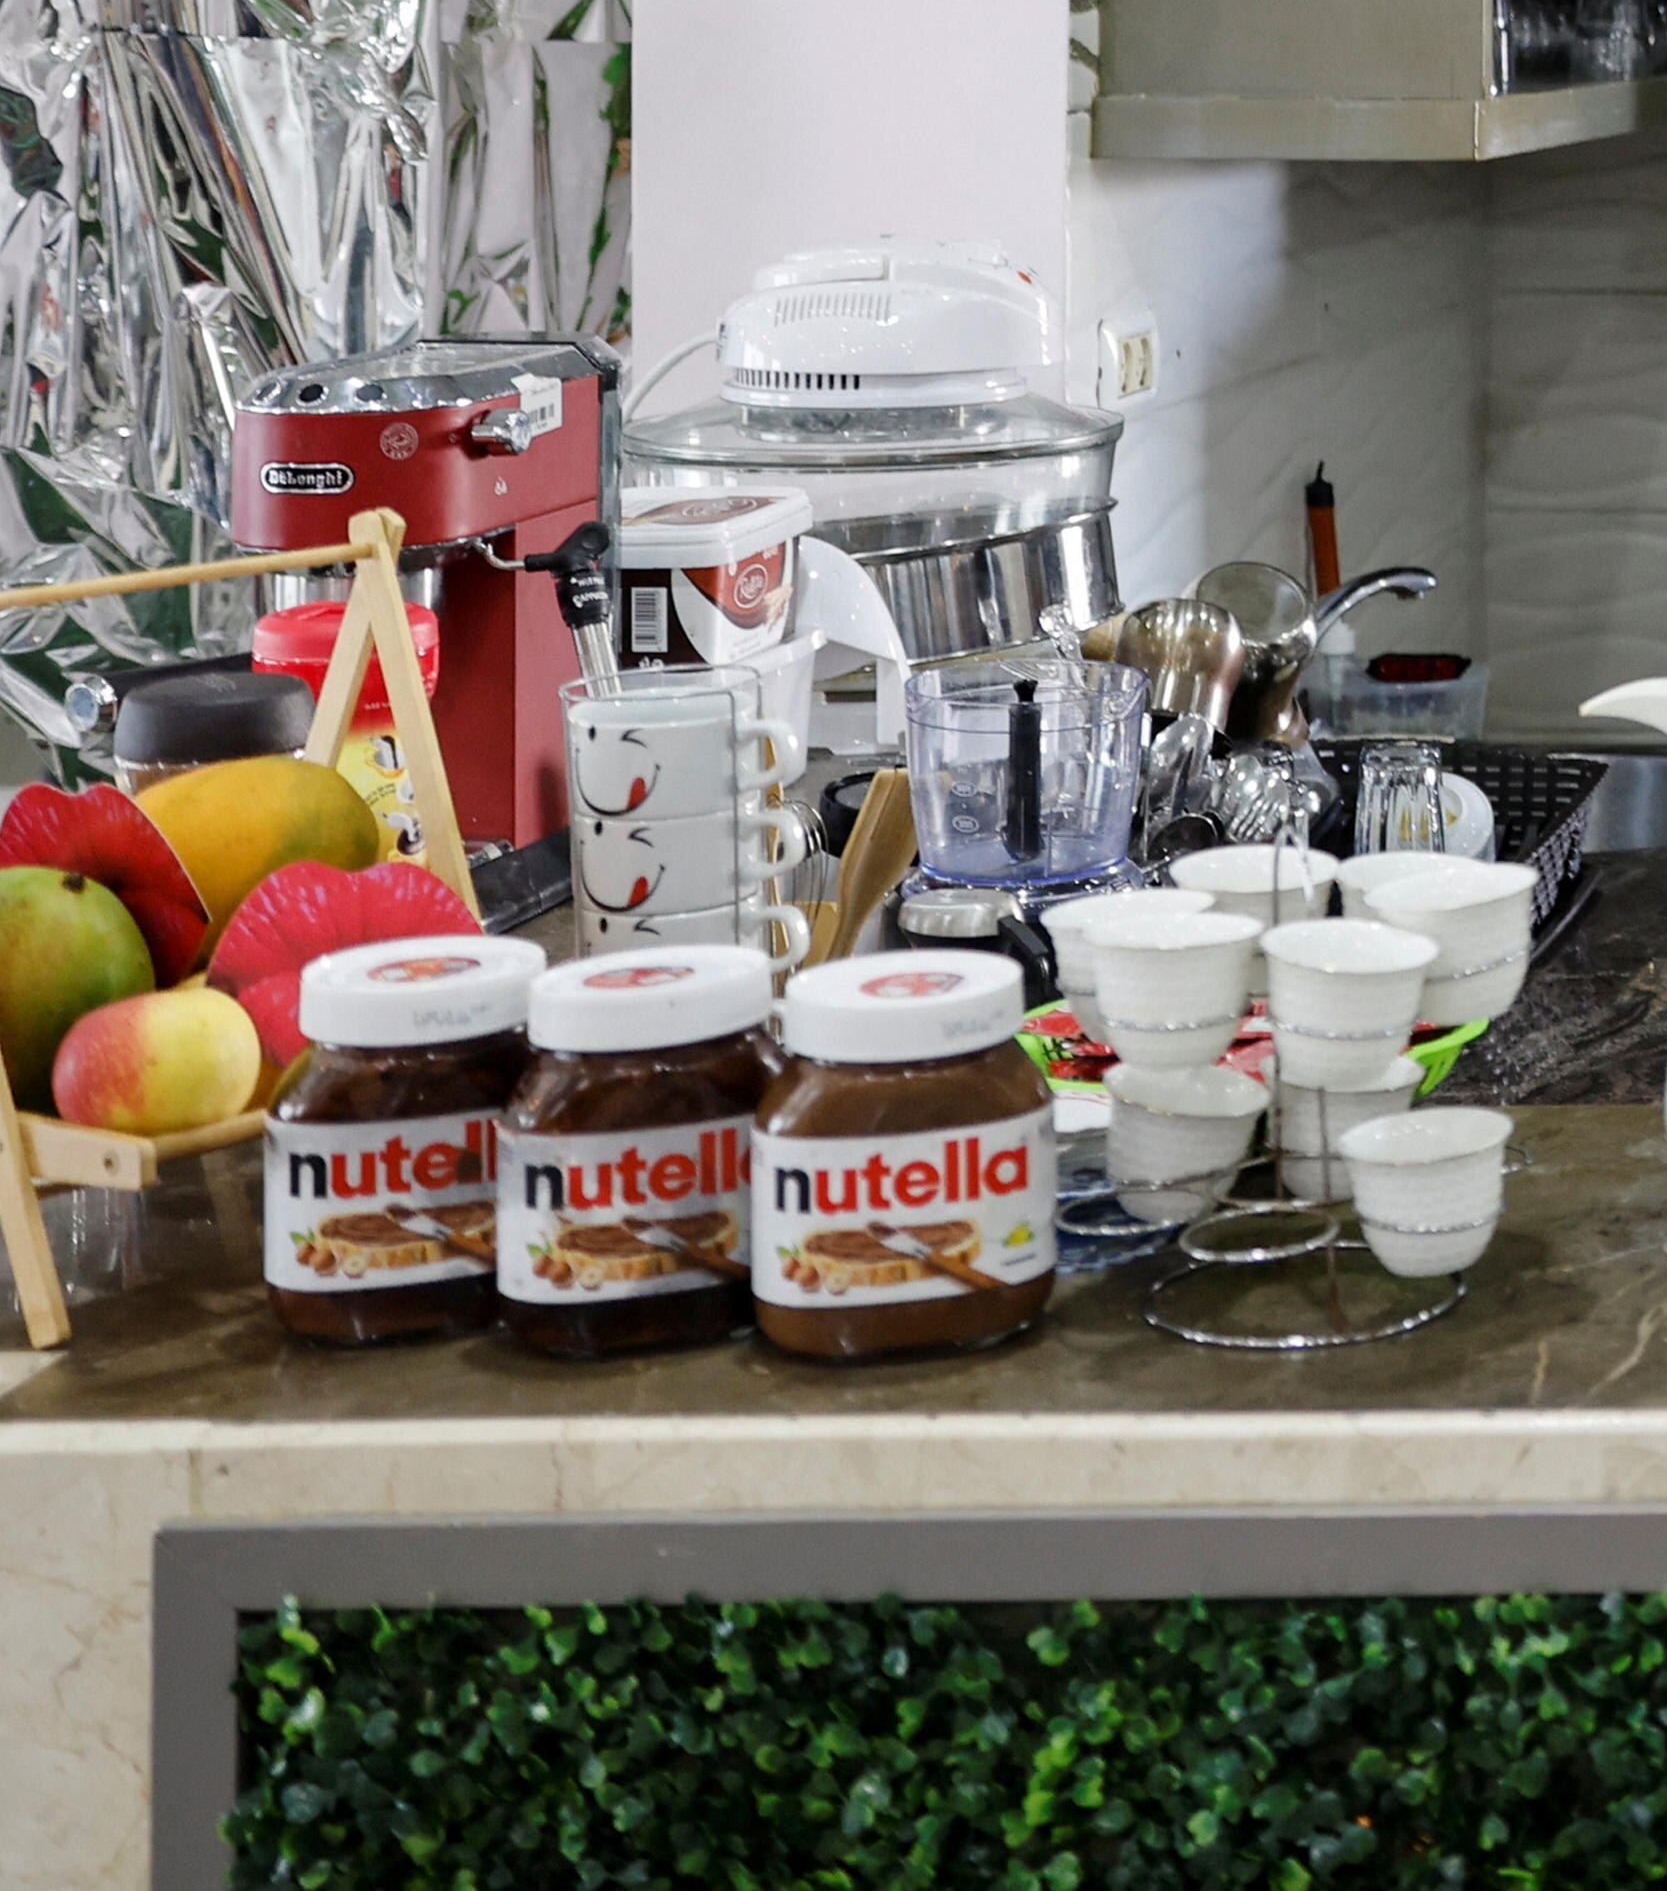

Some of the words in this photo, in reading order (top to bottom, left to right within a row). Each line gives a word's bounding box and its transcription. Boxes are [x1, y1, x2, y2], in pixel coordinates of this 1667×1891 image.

[289, 1119, 497, 1199] nutell
[525, 1126, 752, 1212] nutell
[775, 1136, 1028, 1215] nutella
